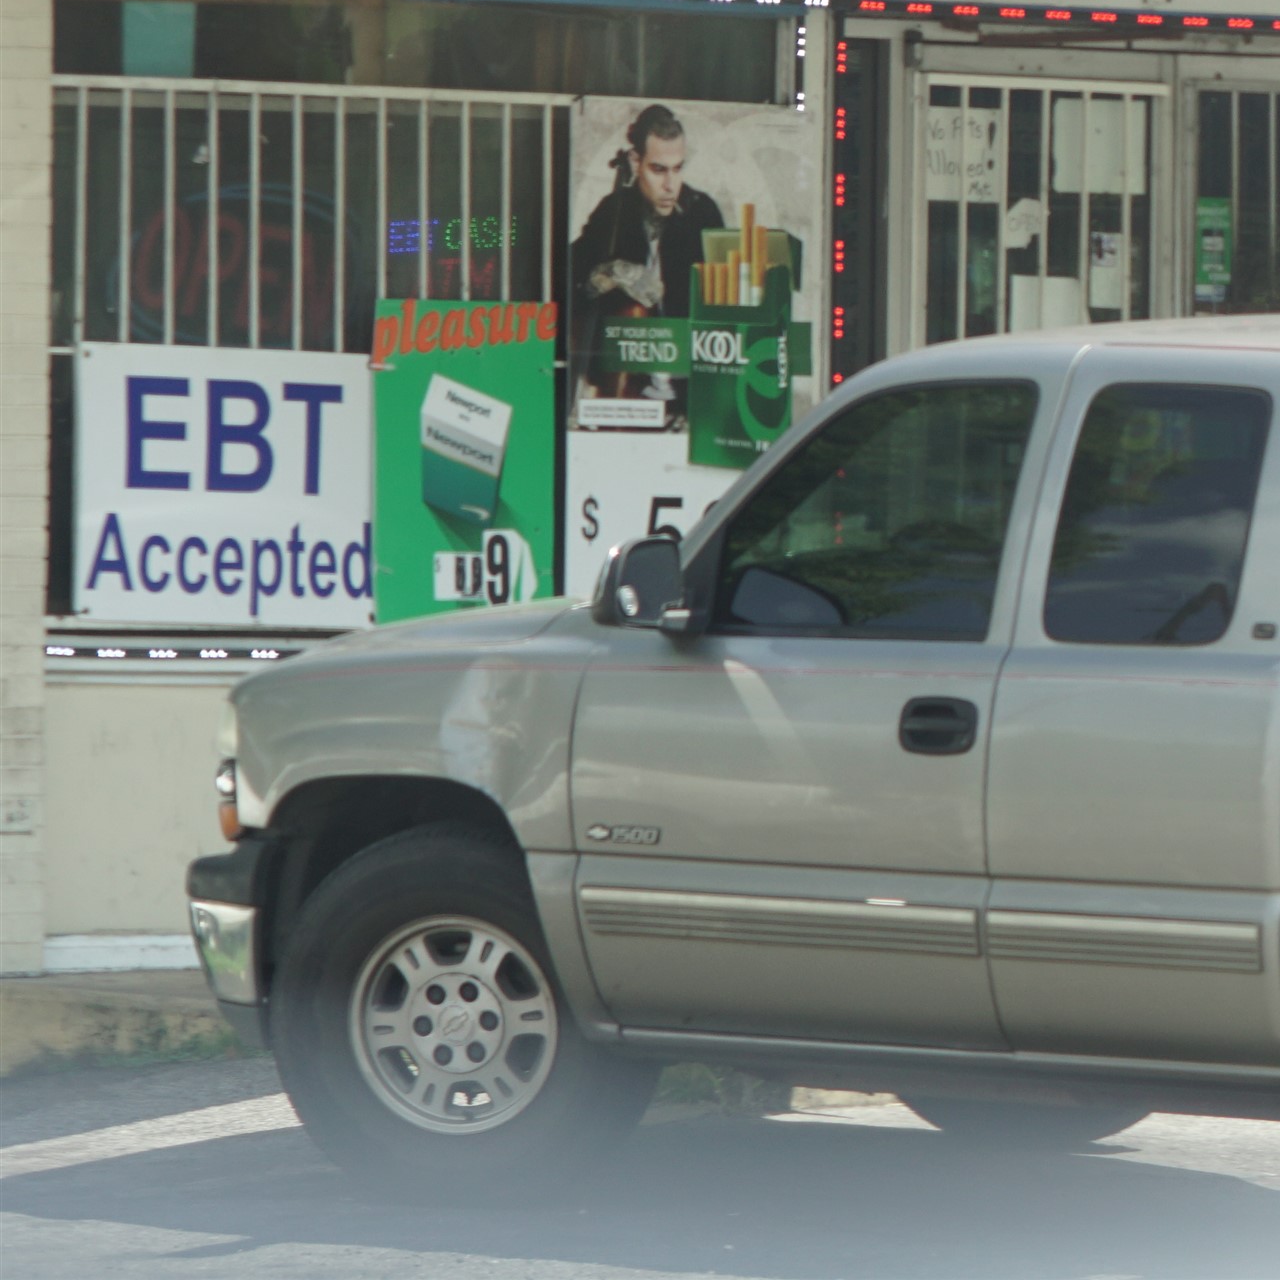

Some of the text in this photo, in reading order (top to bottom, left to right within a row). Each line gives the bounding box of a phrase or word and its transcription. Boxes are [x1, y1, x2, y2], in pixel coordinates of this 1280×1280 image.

[372, 297, 558, 370] pleasure
[618, 340, 678, 363] TREND
[691, 330, 749, 364] KOOL
[446, 391, 493, 418] Newport
[125, 375, 343, 496] EBT
[426, 426, 495, 465] Newport
[581, 494, 598, 546] $
[86, 513, 373, 616] Accepted
